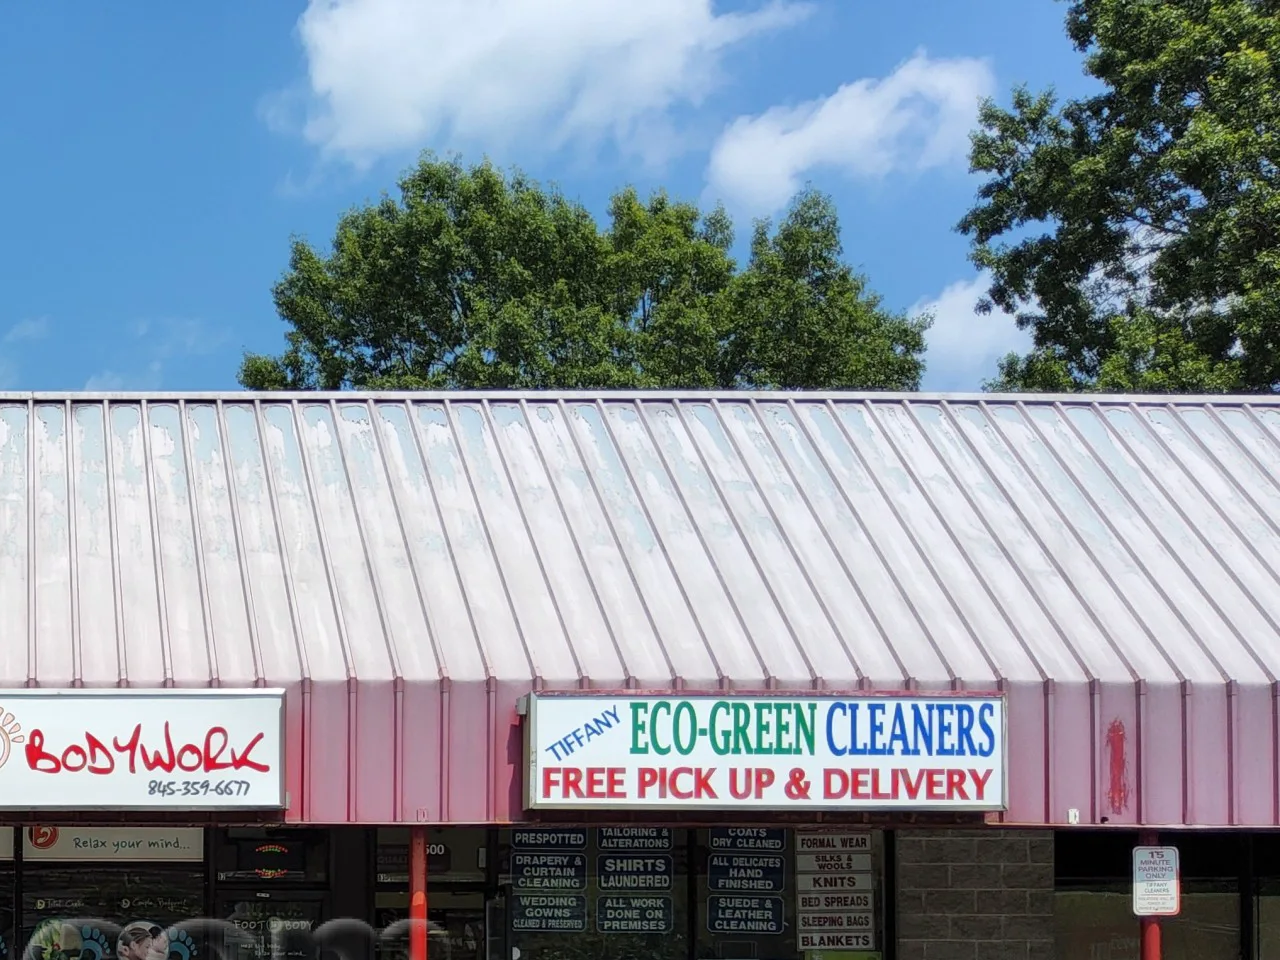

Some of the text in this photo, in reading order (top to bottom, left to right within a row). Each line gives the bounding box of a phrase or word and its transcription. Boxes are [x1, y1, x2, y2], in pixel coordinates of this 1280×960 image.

[544, 704, 621, 763] TIFFANY
[629, 701, 996, 757] ECO-GREEN CLEANERS
[24, 720, 270, 775] BODYWORK
[148, 780, 251, 796] 845-359-6677
[542, 767, 994, 800] FREE PICK UP & DELIVERY
[601, 828, 669, 836] TAILORING &
[728, 828, 767, 837] COATS
[515, 833, 585, 844] PRESPOTTED
[601, 838, 669, 848] ALTERATIONS
[712, 837, 781, 849] DRY CLEANED
[801, 837, 867, 849] FORMAL WEAR
[73, 837, 107, 848] Relax
[112, 839, 143, 853] your
[516, 856, 582, 866] DRAPERY &
[605, 859, 666, 872] SHIRTS
[712, 856, 781, 868] ALL DELICATES
[817, 862, 852, 870] WOOLS
[523, 867, 575, 876] CURTAIN
[728, 868, 763, 878] HAND
[517, 878, 580, 888] CLEANING
[601, 875, 669, 888] LAUNDERED
[718, 879, 774, 890] FINISHED
[812, 876, 856, 887] KNITS
[519, 897, 577, 907] WEDDING
[605, 898, 665, 908] ALL WORK
[718, 898, 773, 908] SUEDE &
[801, 896, 869, 907] BED SPREADS
[525, 908, 572, 918] GOWNS
[607, 909, 663, 919] DONE ON
[718, 909, 773, 919] LEATHER
[233, 920, 315, 930] FOOT BODY
[513, 919, 539, 928] CLEANED
[603, 920, 666, 930] PREMISES
[714, 920, 776, 931] CLEANING
[801, 916, 870, 927] SLEEPING BAGS
[801, 935, 870, 947] BLANKETS
